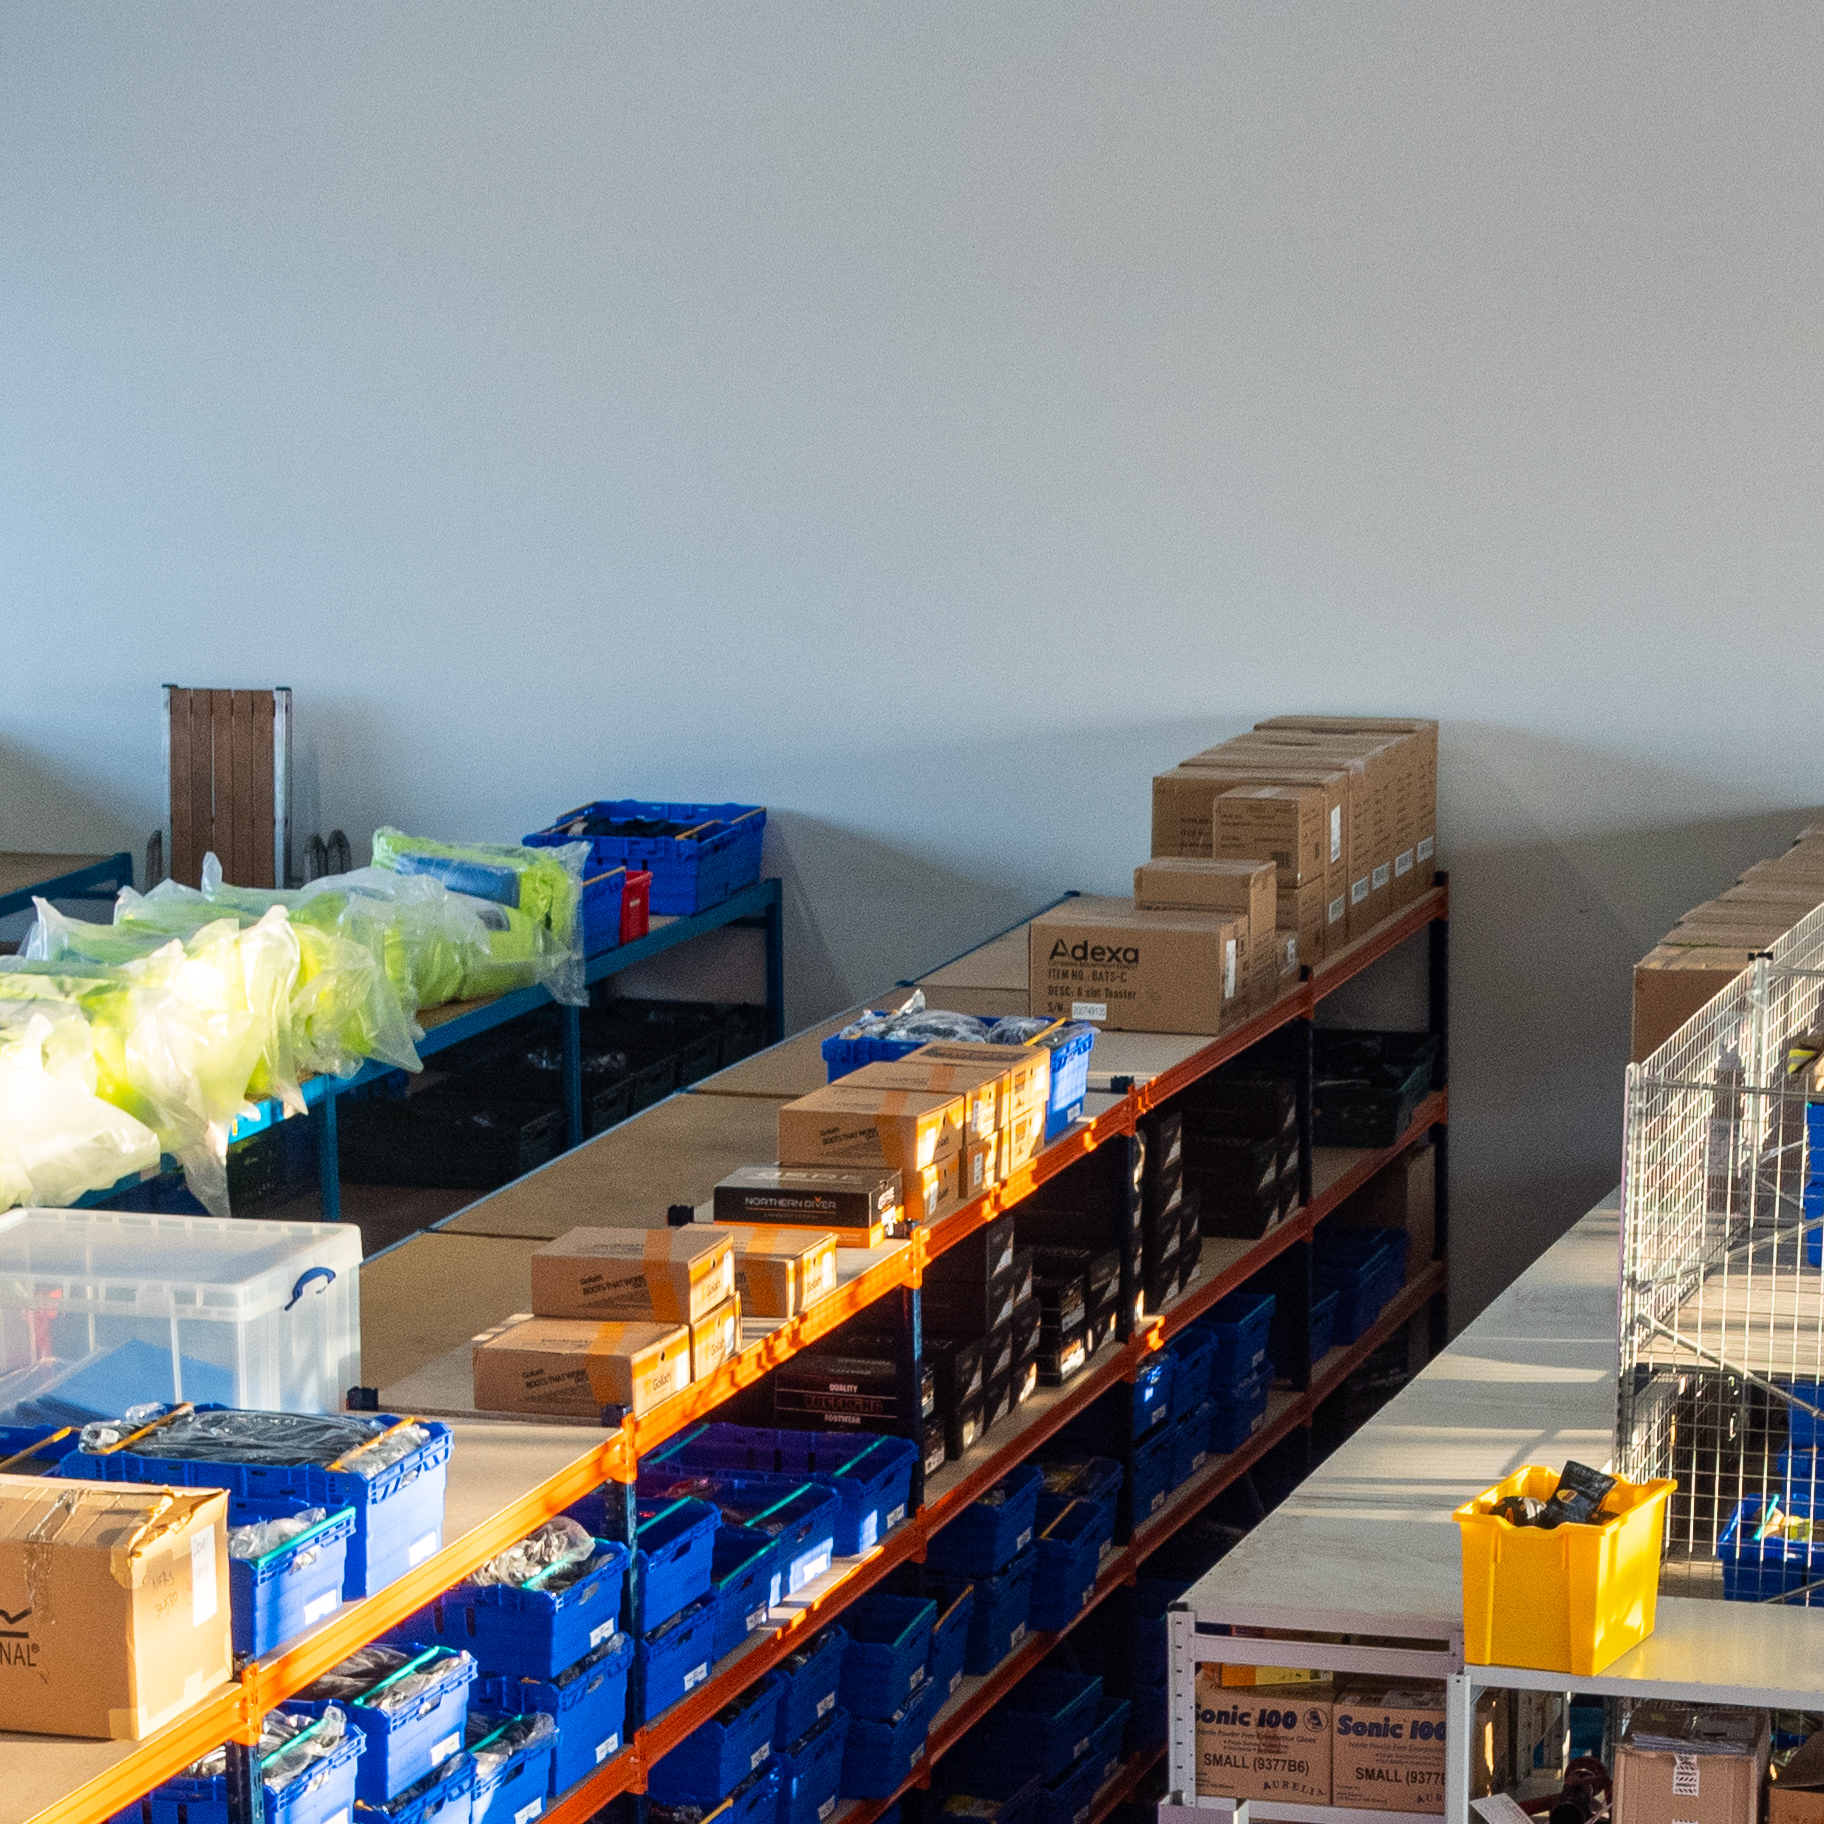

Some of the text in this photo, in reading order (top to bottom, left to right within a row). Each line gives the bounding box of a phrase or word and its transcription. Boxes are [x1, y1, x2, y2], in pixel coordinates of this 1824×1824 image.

[1049, 939, 1139, 964] Adexa
[1048, 969, 1069, 980] ITEM
[745, 1197, 836, 1210] NORTHERN DIVER
[652, 1371, 672, 1392] Goliath
[829, 1383, 858, 1394] QUALITY
[824, 1413, 861, 1425] FOOTWEAR
[1258, 1708, 1298, 1730] 100
[1337, 1714, 1404, 1740] Sonic
[1204, 1752, 1310, 1777] SMALL (9377B6)
[1356, 1767, 1401, 1784] SMALL
